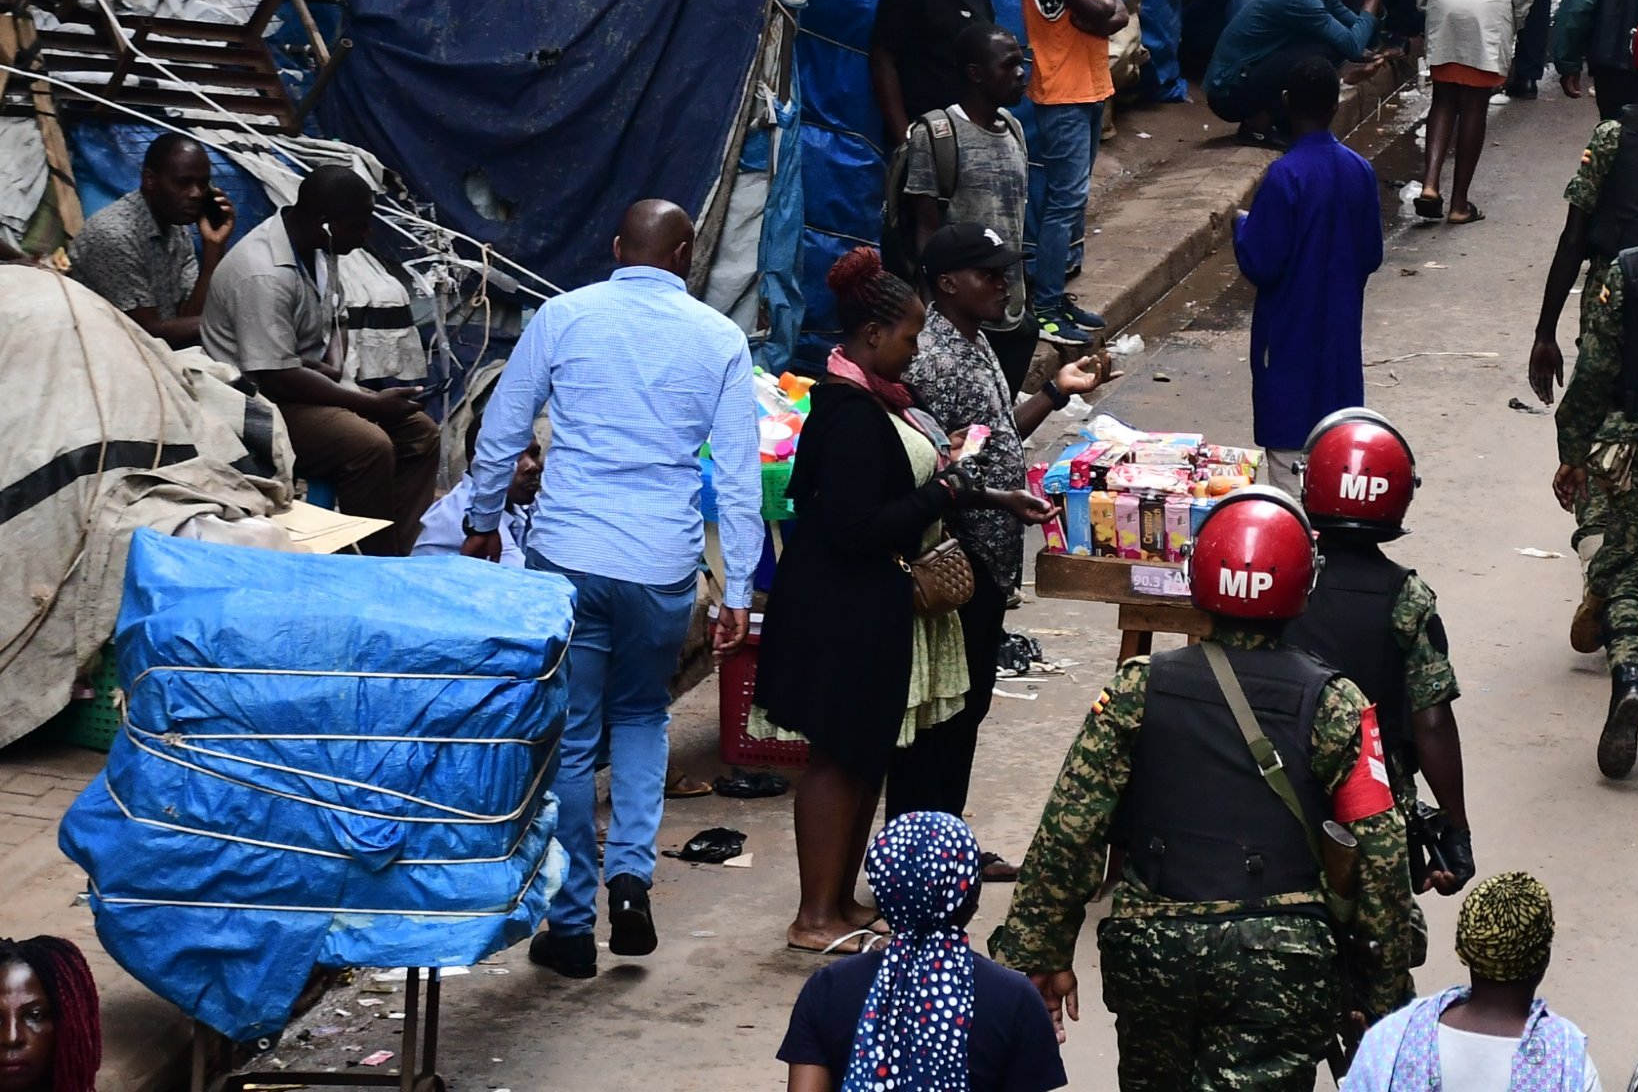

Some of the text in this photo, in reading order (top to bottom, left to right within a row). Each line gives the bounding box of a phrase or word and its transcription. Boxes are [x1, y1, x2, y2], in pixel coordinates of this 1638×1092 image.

[1339, 473, 1389, 502] MP
[1133, 574, 1160, 588] 90.3
[1219, 567, 1274, 600] MP
